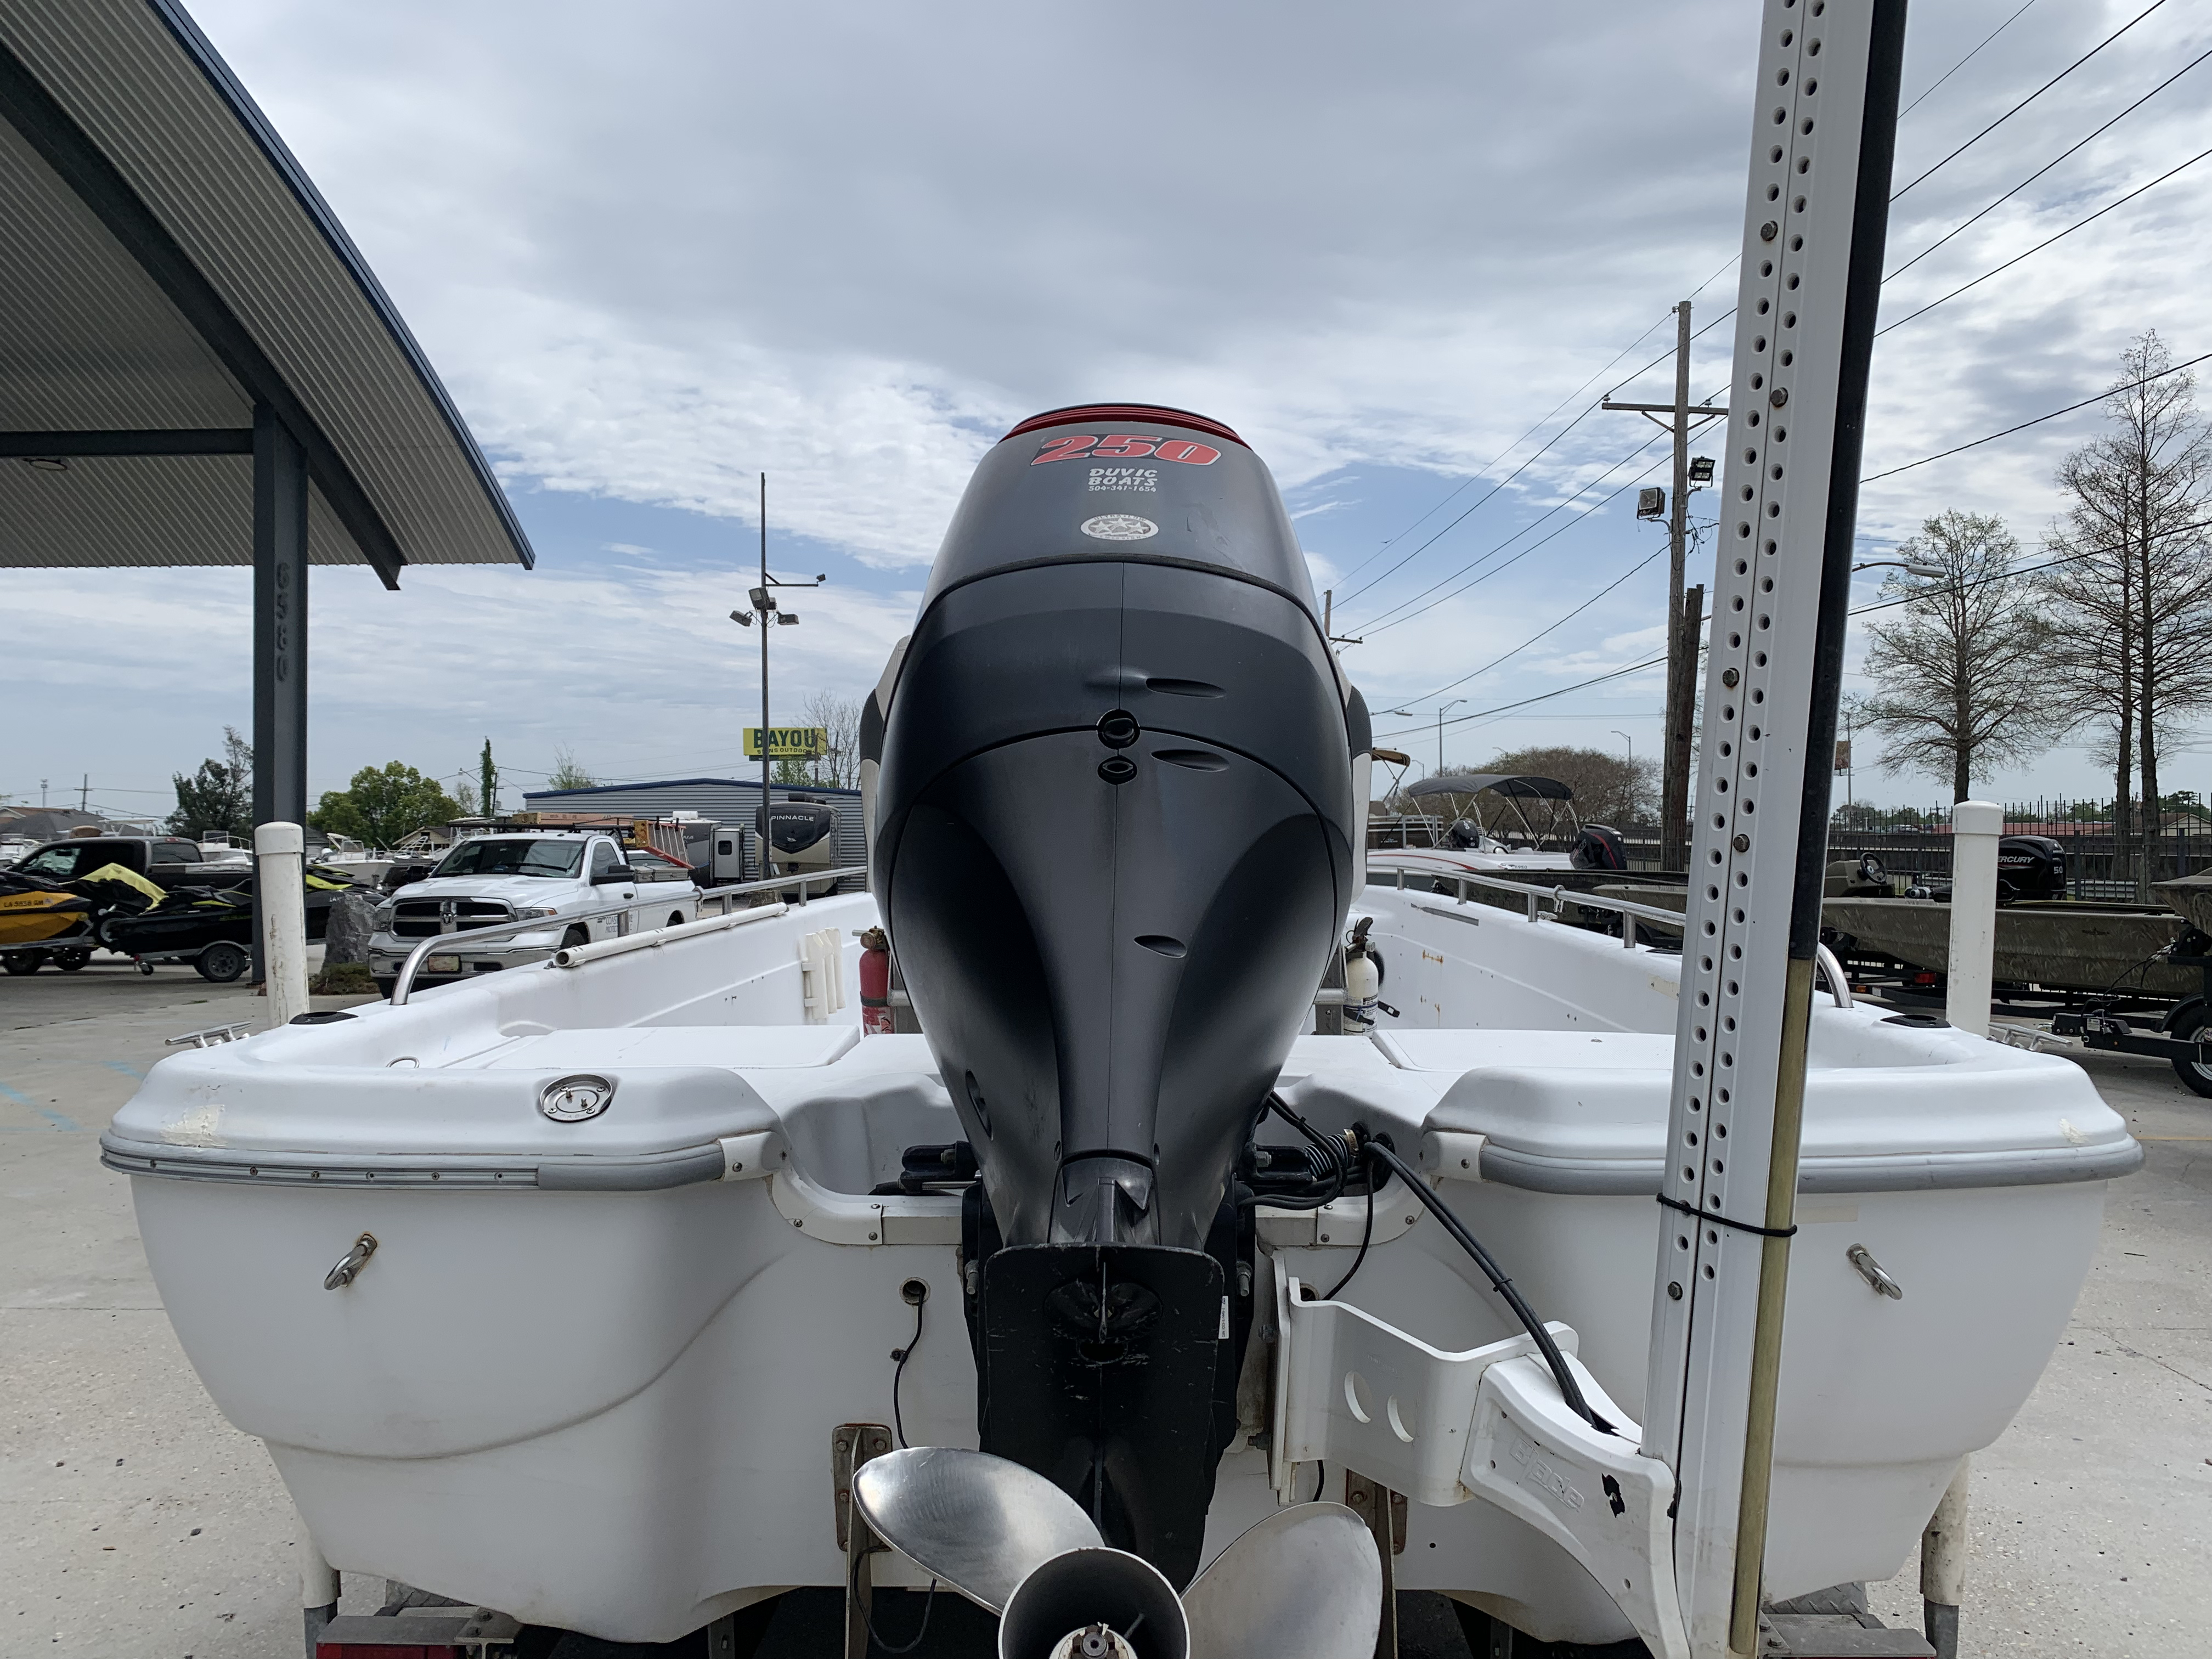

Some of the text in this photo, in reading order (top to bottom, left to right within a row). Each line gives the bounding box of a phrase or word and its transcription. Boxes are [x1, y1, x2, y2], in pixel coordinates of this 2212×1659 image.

[1031, 434, 1222, 466] 250
[1090, 468, 1158, 477] DUVIC
[1088, 477, 1158, 486] BOATS
[753, 729, 815, 748] BAYOU
